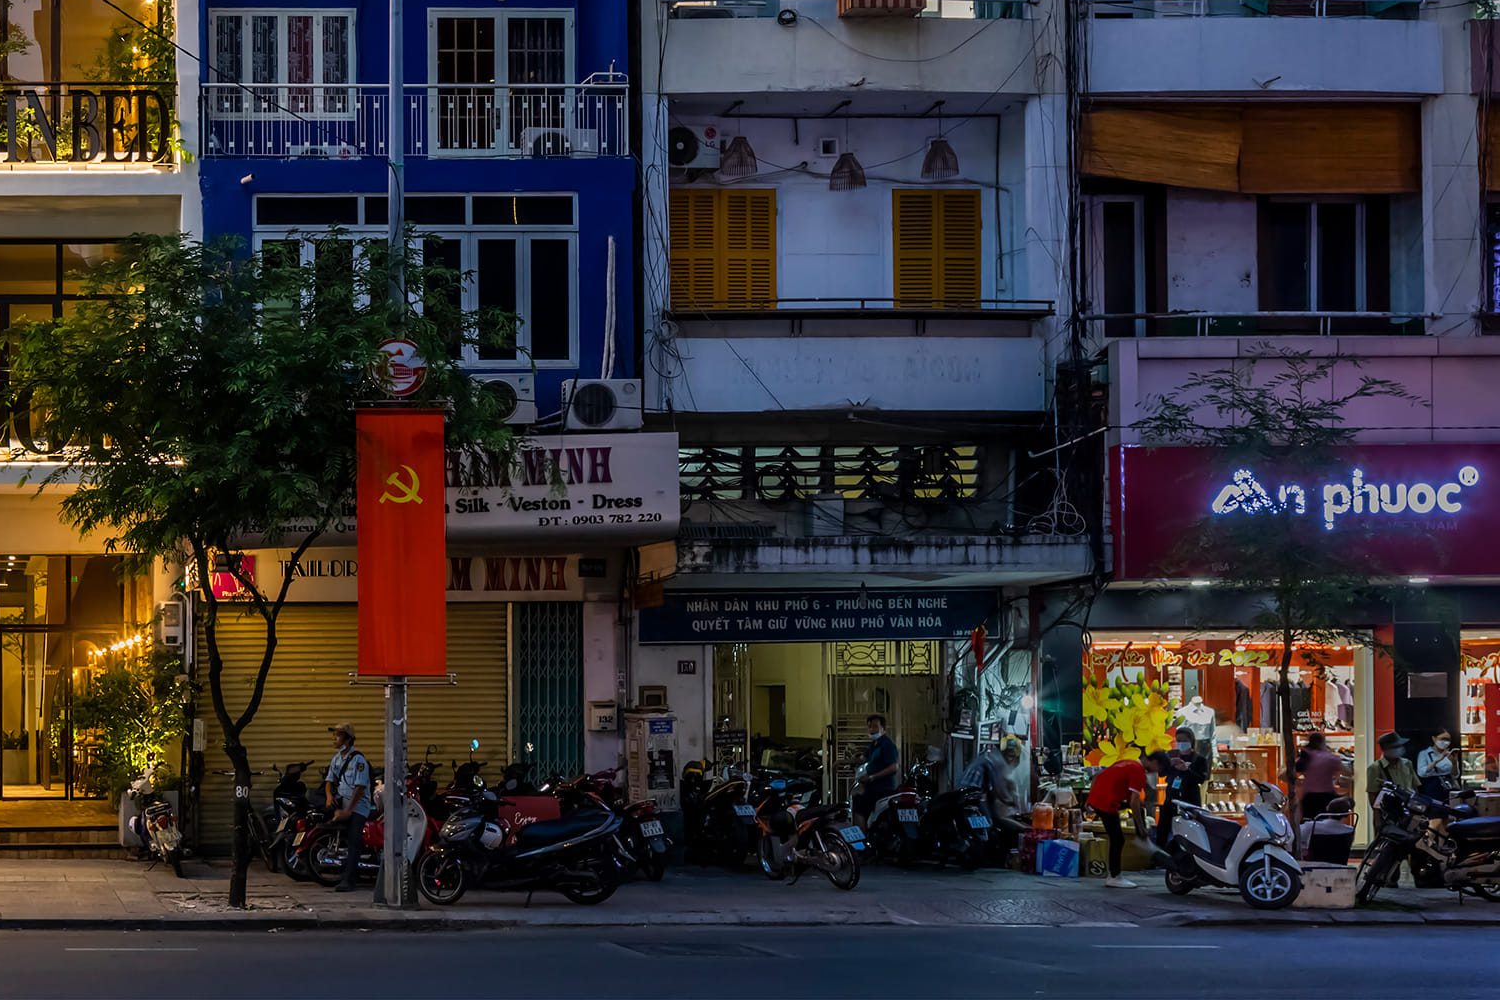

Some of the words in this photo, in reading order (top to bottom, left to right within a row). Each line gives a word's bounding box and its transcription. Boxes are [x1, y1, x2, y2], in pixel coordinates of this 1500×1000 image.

[523, 447, 612, 486] MINH
[1212, 469, 1305, 514] An
[456, 498, 490, 513] Silk
[510, 496, 571, 511] Veston
[587, 494, 643, 509] Dress
[539, 517, 561, 526] ĐT
[572, 513, 604, 524] 0903
[609, 511, 632, 523] 782
[638, 510, 663, 522] 220
[1426, 520, 1458, 530] NAM
[278, 560, 357, 577] TAILOR
[484, 557, 567, 590] MINH
[686, 597, 719, 612] NHÂN
[724, 597, 749, 612] DÂN
[755, 599, 780, 611] KHU
[785, 596, 808, 611] PHỐ
[813, 599, 820, 610] 6
[888, 596, 912, 610] BẾN
[692, 616, 730, 632] QUYẾT
[737, 616, 763, 630] TÂM
[767, 616, 788, 630] GIỮ
[795, 615, 827, 629] VỮNG
[831, 617, 855, 629] KHU
[861, 614, 885, 628] PHỐ
[918, 613, 942, 628] HÓA
[1219, 649, 1269, 666] 2022
[236, 785, 249, 799] 80
